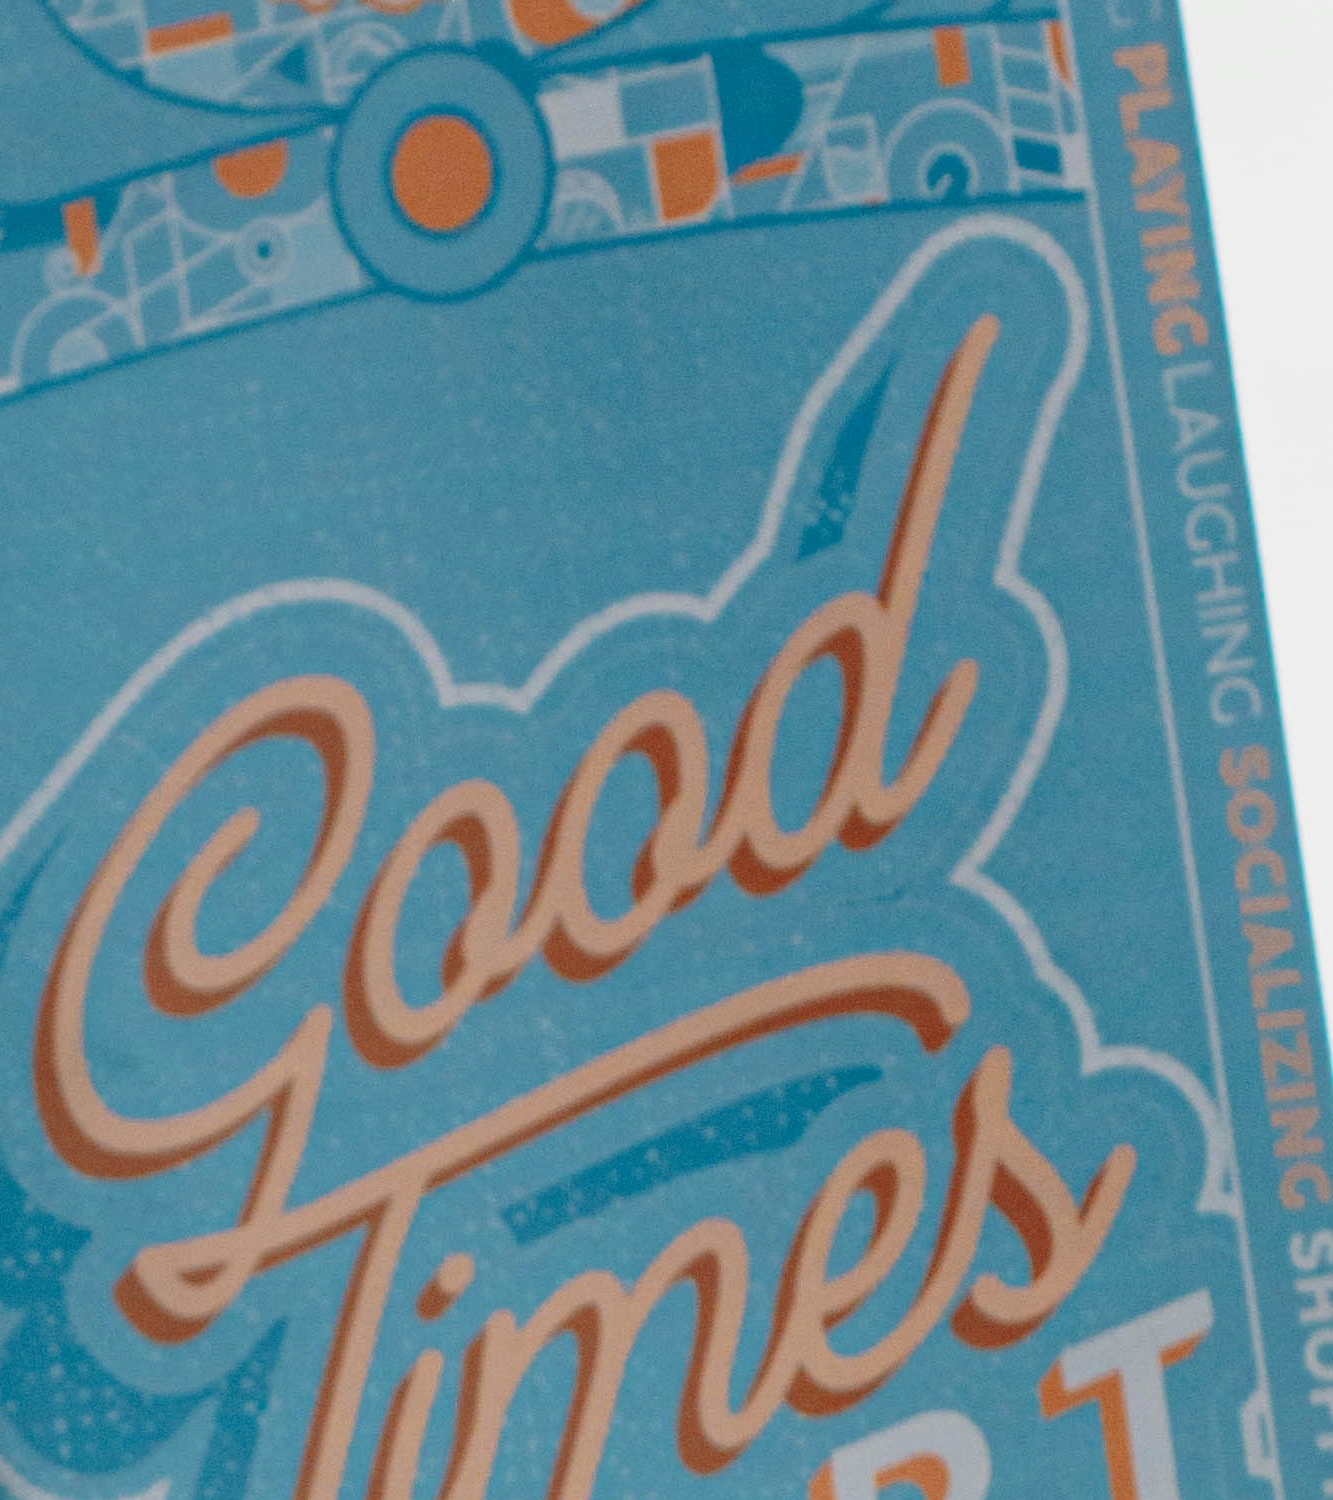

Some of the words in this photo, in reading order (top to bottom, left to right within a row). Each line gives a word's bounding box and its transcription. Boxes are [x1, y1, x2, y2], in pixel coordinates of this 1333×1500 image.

[32, 314, 1000, 1343] Good
[1112, 41, 1209, 356] PLAYING
[1161, 360, 1263, 728] LAUGHING
[1218, 744, 1332, 1212] SOCIALIZING
